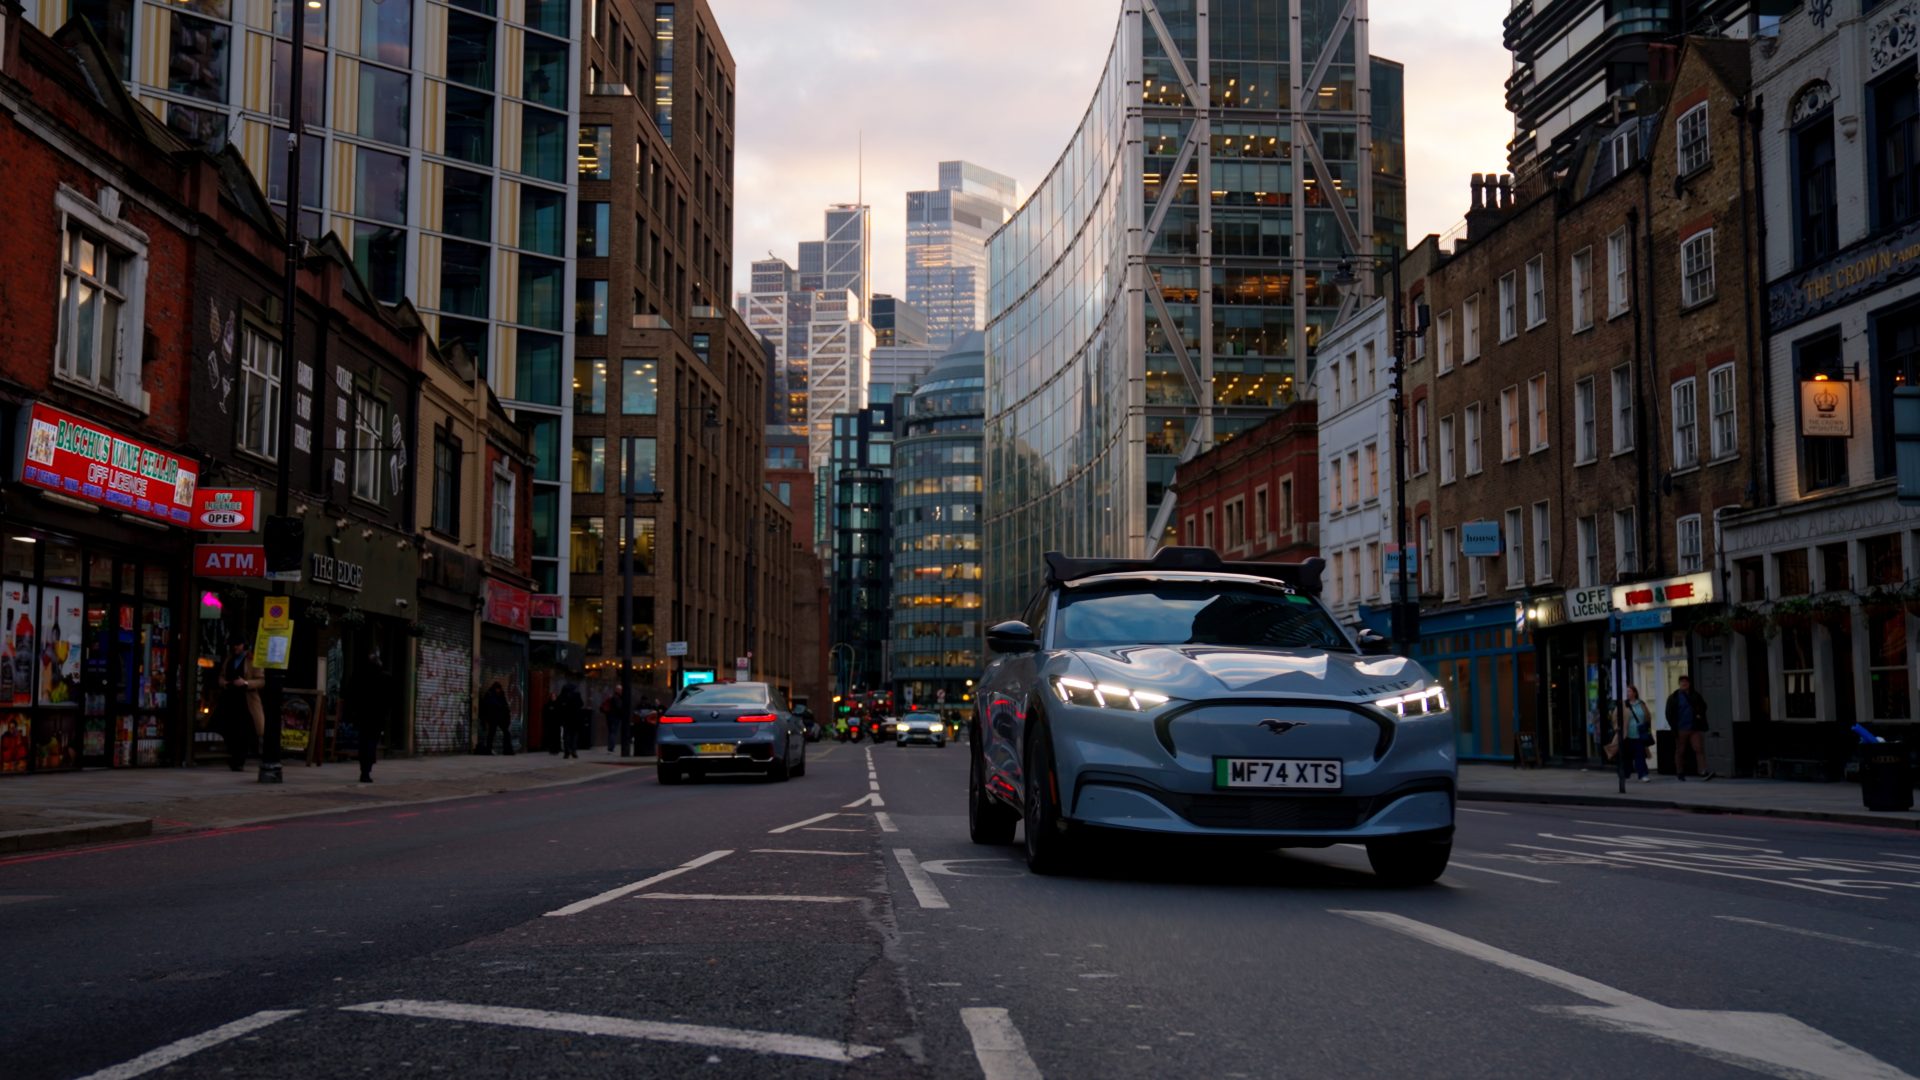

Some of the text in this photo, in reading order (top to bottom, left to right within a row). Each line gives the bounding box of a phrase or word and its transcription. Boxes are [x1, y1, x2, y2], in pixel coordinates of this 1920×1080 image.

[1804, 274, 1833, 304] THE
[1836, 249, 1892, 289] CROWN
[56, 418, 179, 485] BACCHUS WINE CELLAR
[87, 463, 148, 498] OFF LICENCE
[208, 513, 236, 523] OPEN
[1466, 533, 1497, 543] house
[205, 552, 254, 569] ATM
[337, 560, 363, 588] EDGE
[1576, 589, 1606, 604] OFF
[1572, 601, 1613, 618] LICENCE
[1232, 761, 1337, 784] MF74 XTS
